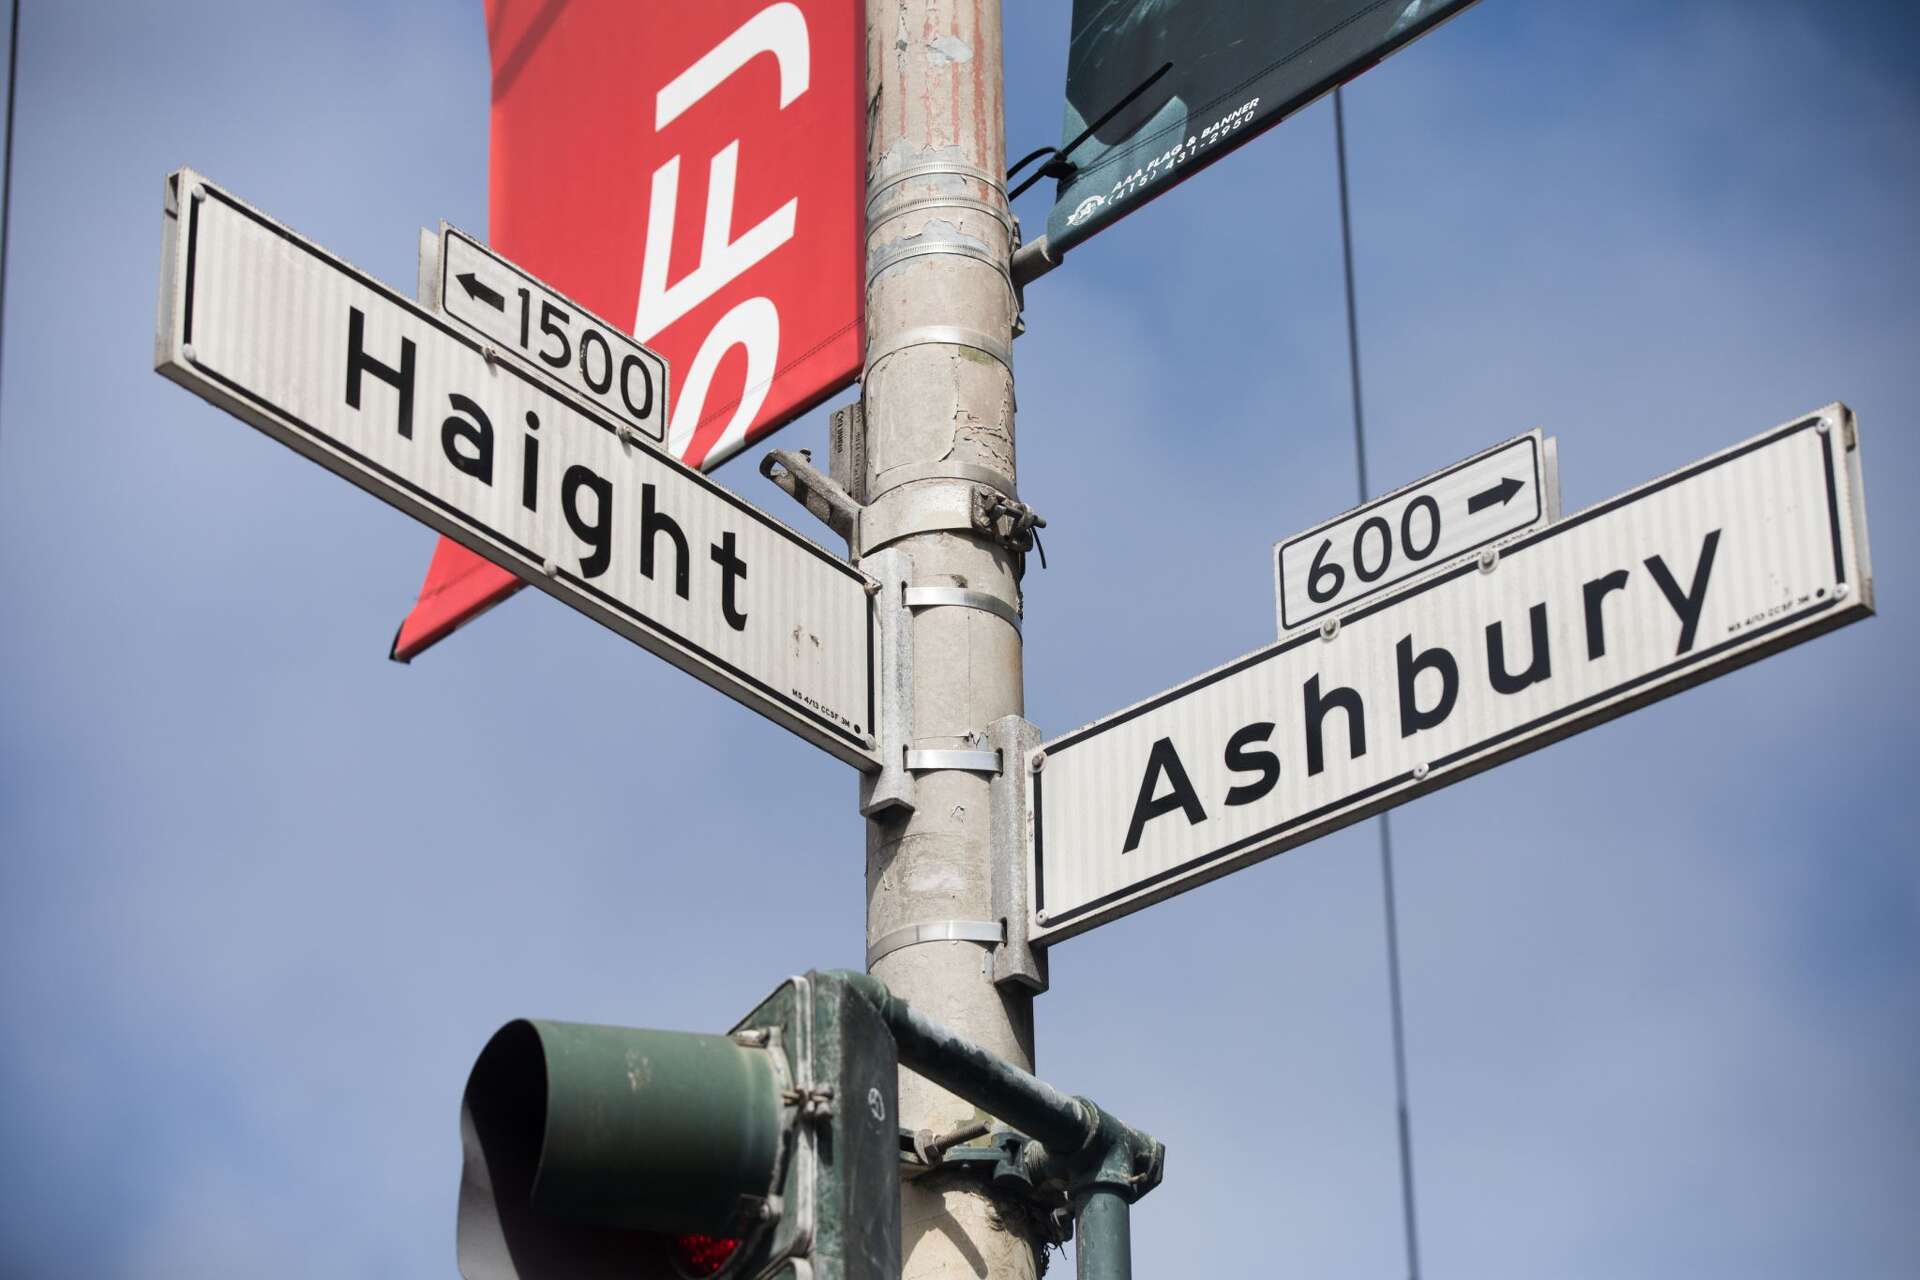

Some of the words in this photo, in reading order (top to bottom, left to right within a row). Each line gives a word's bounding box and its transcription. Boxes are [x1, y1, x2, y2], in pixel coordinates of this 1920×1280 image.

[1107, 170, 1157, 206] (415)
[1164, 110, 1255, 170] 431-2950
[1111, 167, 1143, 193] AAA
[1147, 143, 1184, 171] FLAG
[1186, 136, 1197, 147] &
[1201, 97, 1260, 139] BANNER
[517, 287, 655, 420] 1500
[345, 305, 748, 632] Haight
[1307, 493, 1442, 603] 600
[820, 705, 839, 720] CCSF
[1121, 528, 1722, 855] Ashbury
